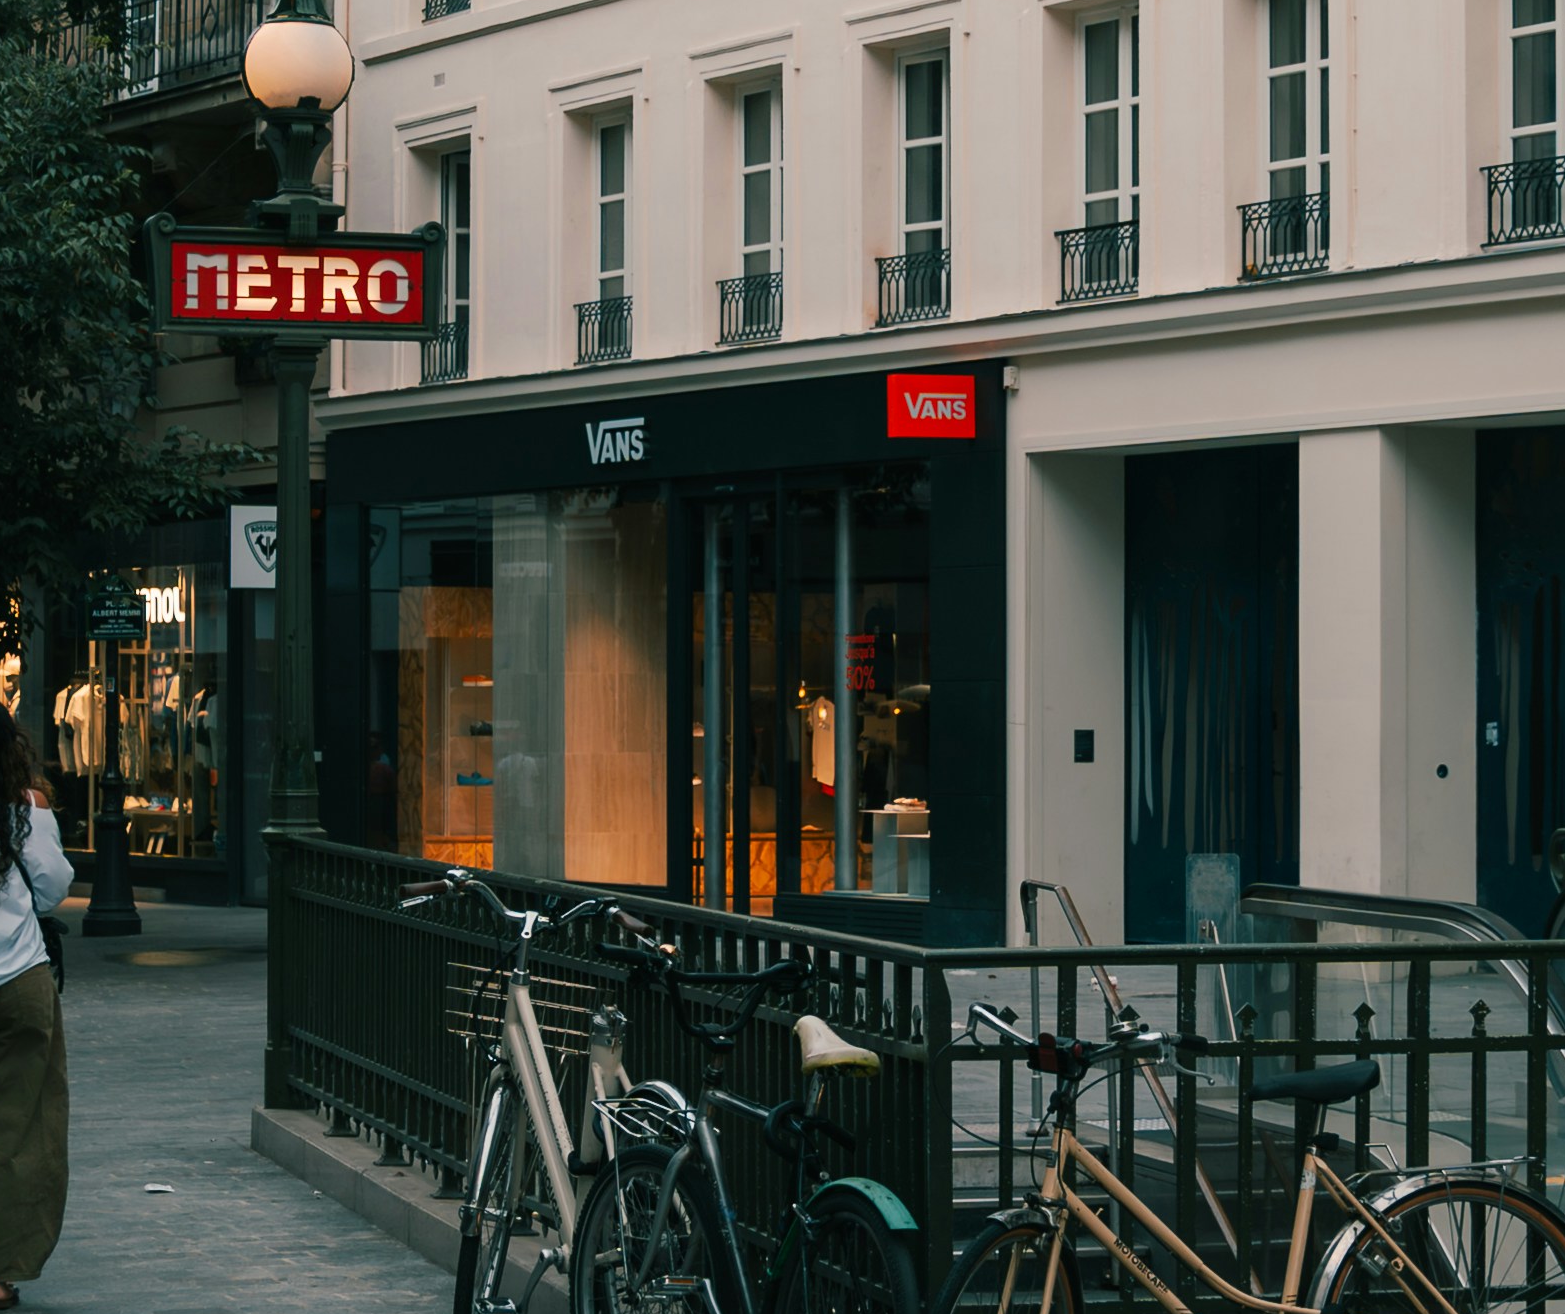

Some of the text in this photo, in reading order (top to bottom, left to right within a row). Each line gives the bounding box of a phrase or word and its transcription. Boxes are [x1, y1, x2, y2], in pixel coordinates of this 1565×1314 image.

[185, 252, 410, 315] METRO
[904, 391, 968, 421] VANS
[585, 417, 646, 466] VANS
[91, 609, 118, 617] ALBERT
[846, 665, 876, 692] 50%
